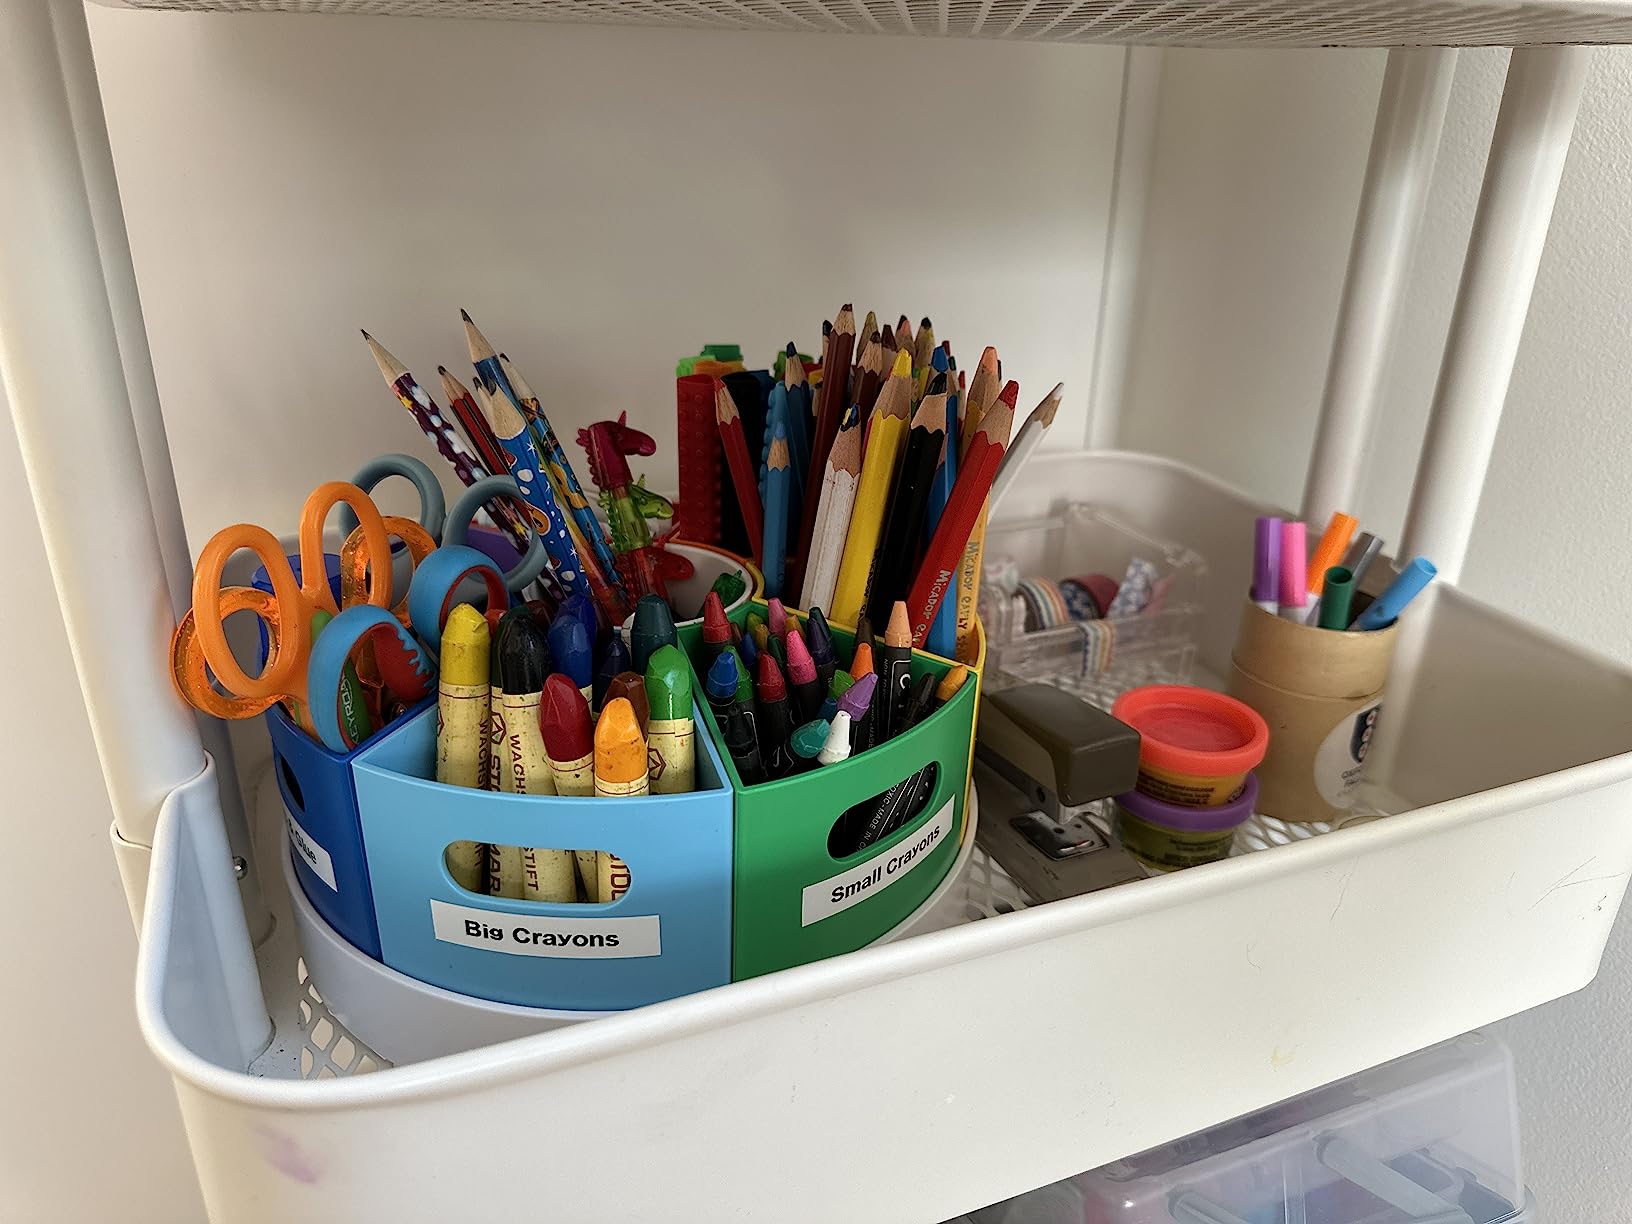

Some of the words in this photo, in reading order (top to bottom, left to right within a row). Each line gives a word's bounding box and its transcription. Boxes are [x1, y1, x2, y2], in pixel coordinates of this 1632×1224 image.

[831, 866, 882, 903] Small
[886, 825, 940, 875] Crayons
[464, 919, 504, 941] Big
[512, 927, 620, 947] Crayons
